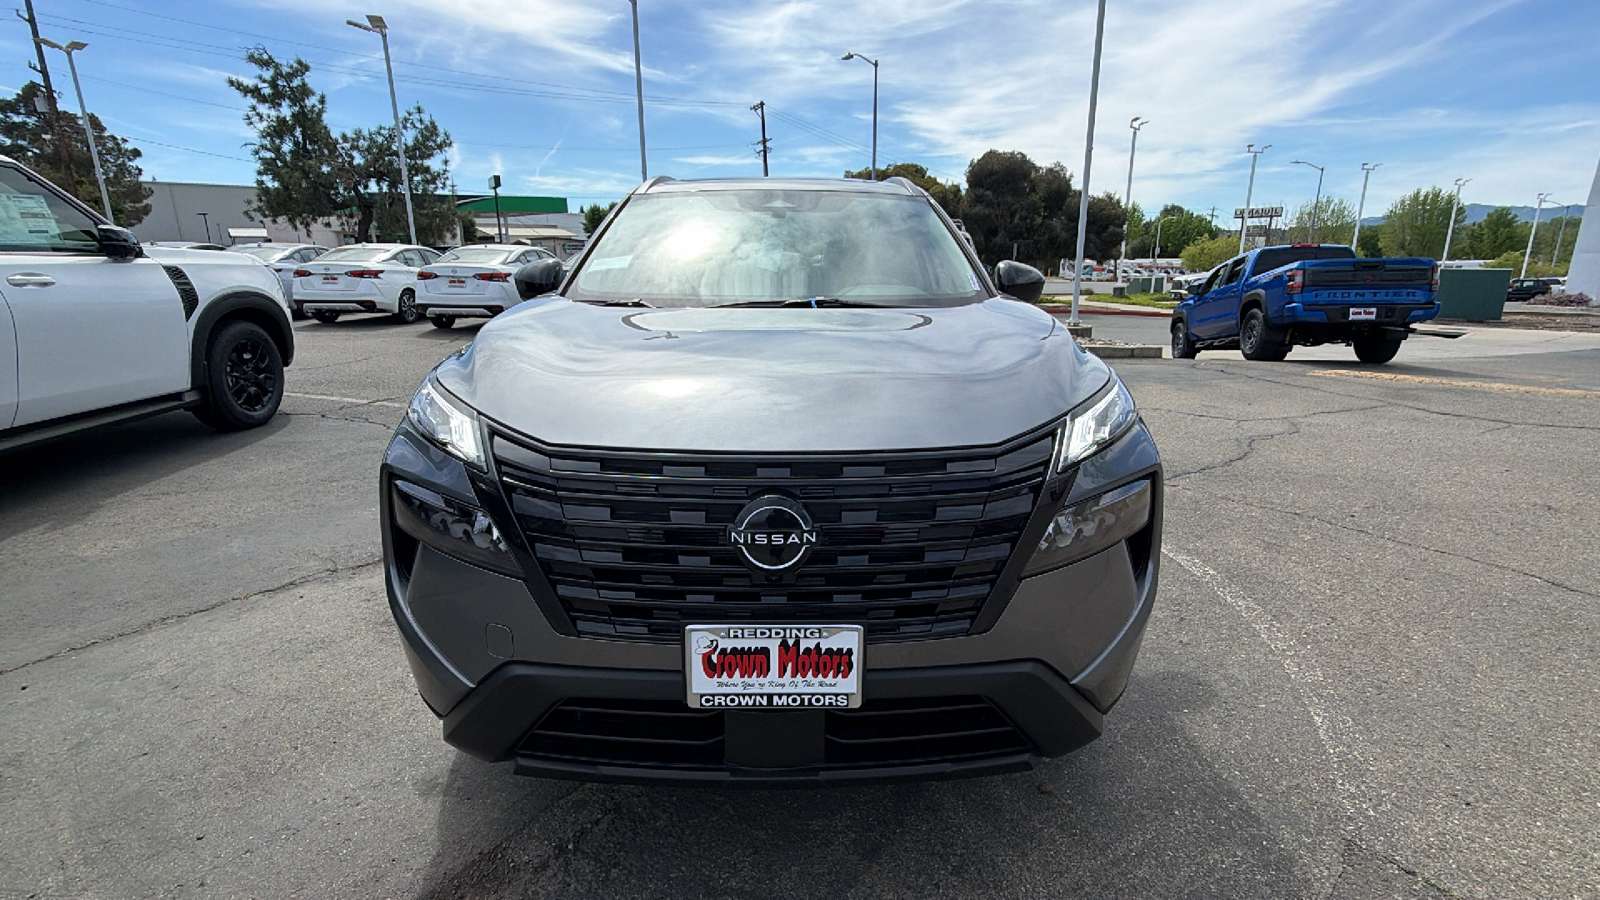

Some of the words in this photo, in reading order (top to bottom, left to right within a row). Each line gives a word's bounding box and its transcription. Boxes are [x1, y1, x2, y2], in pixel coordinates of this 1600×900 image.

[1314, 291, 1418, 299] FRONTIER
[731, 531, 816, 545] NISSAN
[729, 628, 821, 638] REDDING
[702, 643, 770, 679] Crown
[778, 640, 853, 679] Motors
[717, 680, 739, 688] Where
[741, 680, 766, 690] You're
[768, 680, 786, 689] King
[788, 680, 799, 689] Of
[801, 680, 815, 688] The
[701, 695, 768, 706] CROWN
[772, 694, 848, 706] MOTORS
